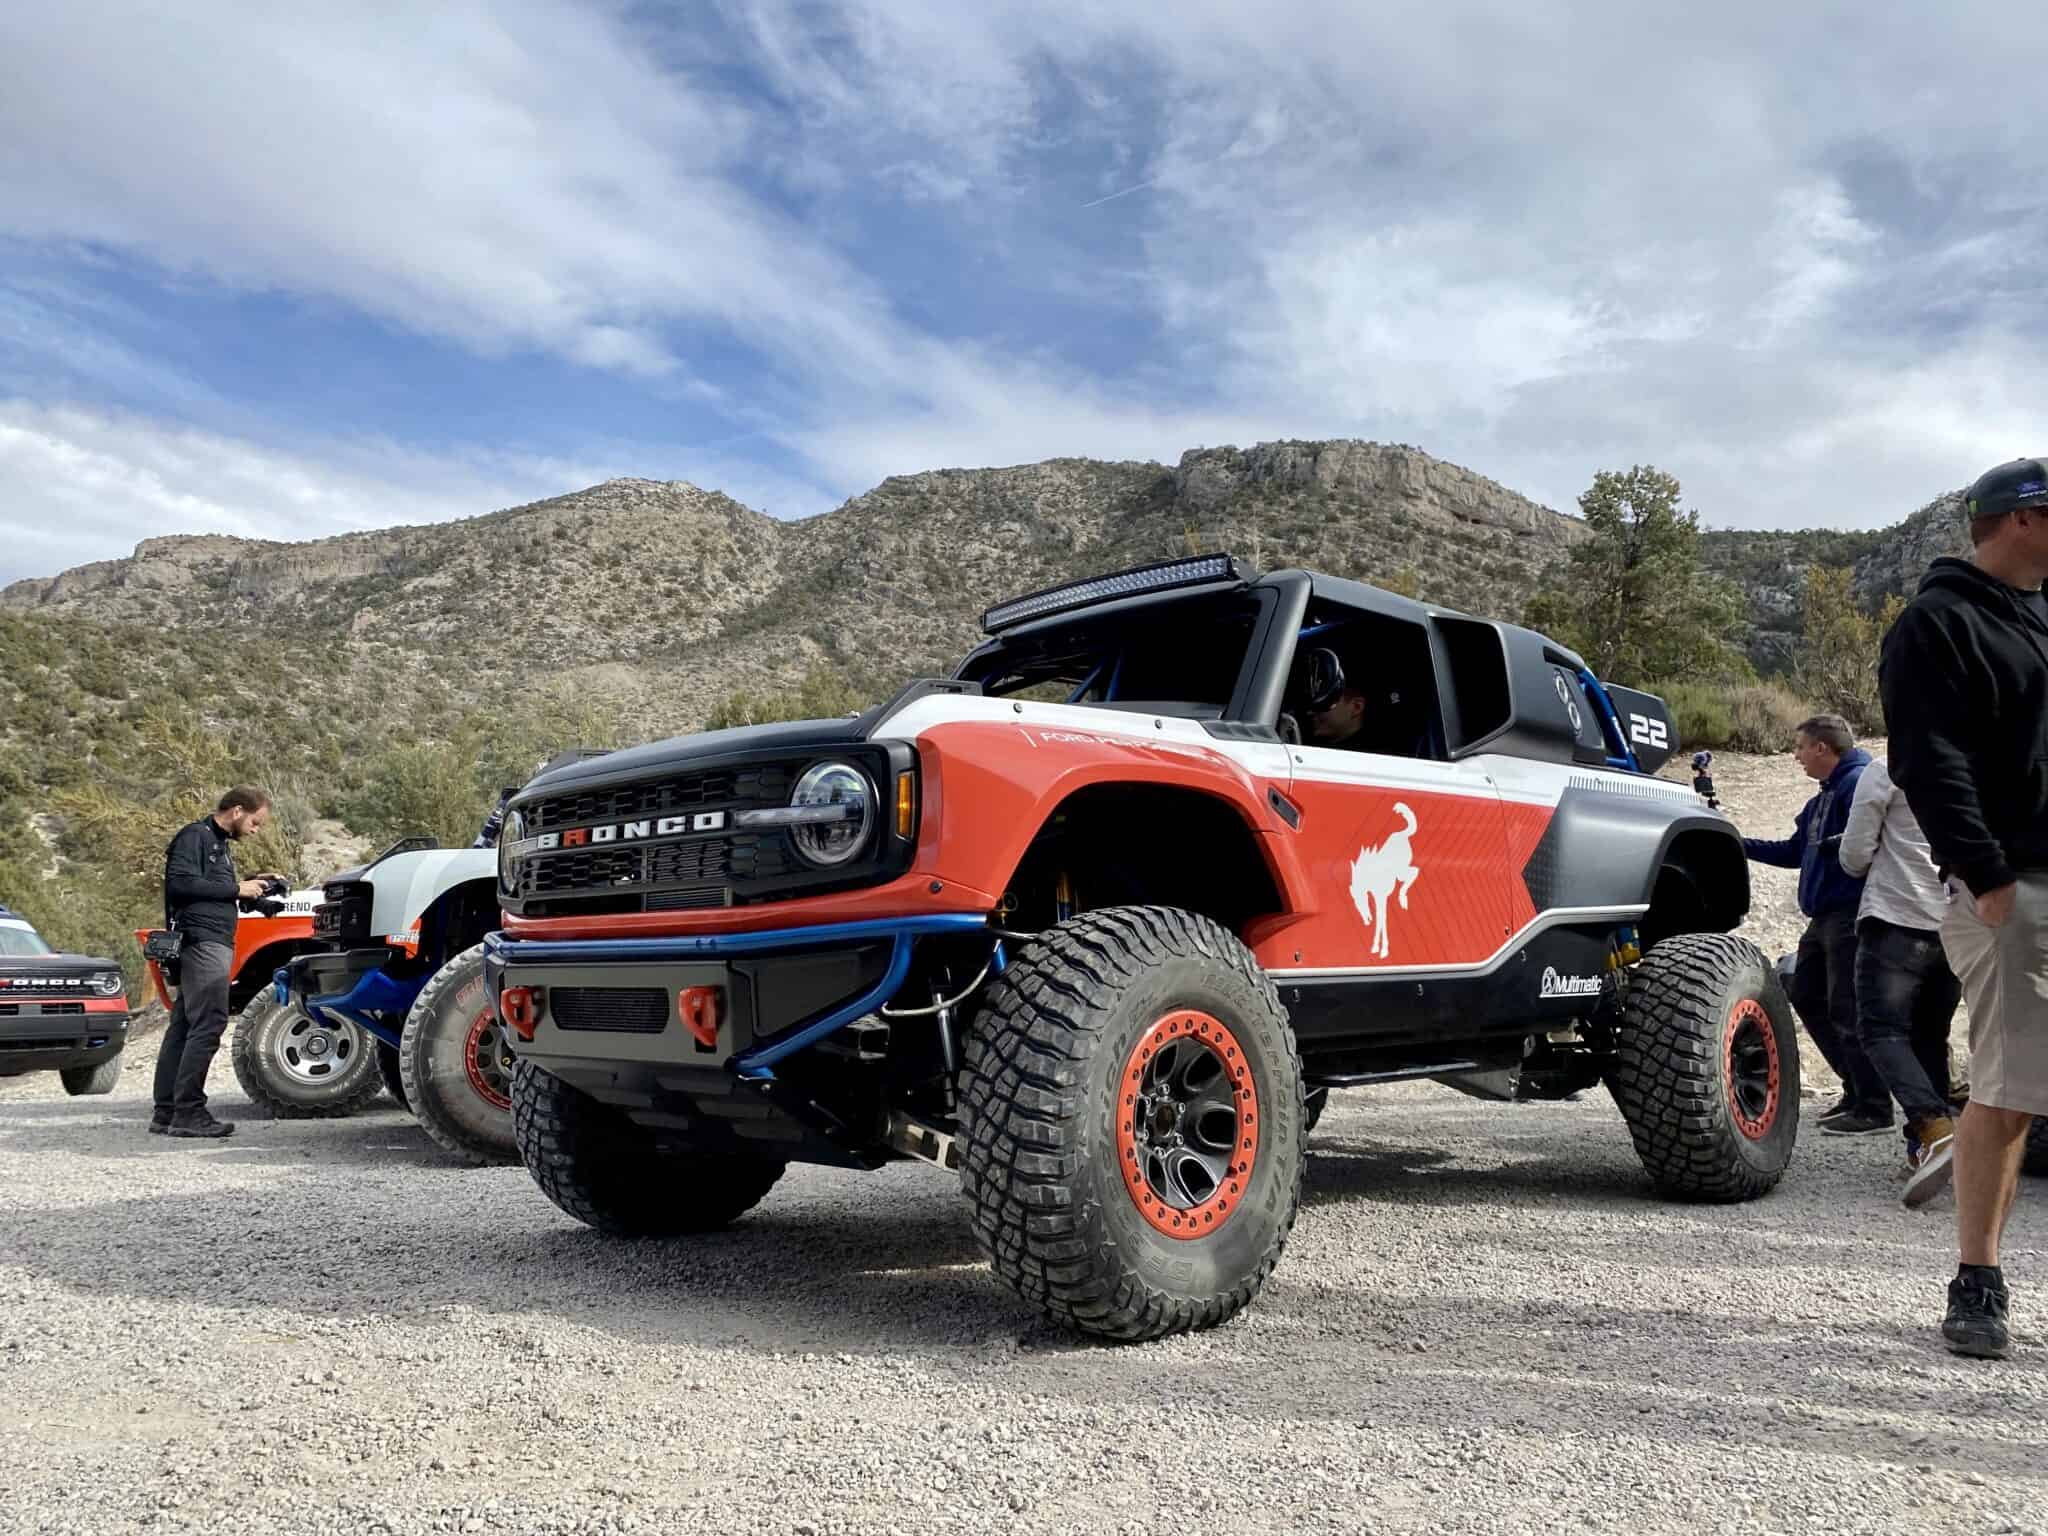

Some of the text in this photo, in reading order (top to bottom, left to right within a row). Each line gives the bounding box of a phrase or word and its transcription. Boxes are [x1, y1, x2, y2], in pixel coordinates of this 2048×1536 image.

[1629, 712, 1669, 750] 22
[537, 811, 725, 849] BRONCO
[284, 901, 311, 912] REND
[1554, 974, 1603, 993] Multimatic
